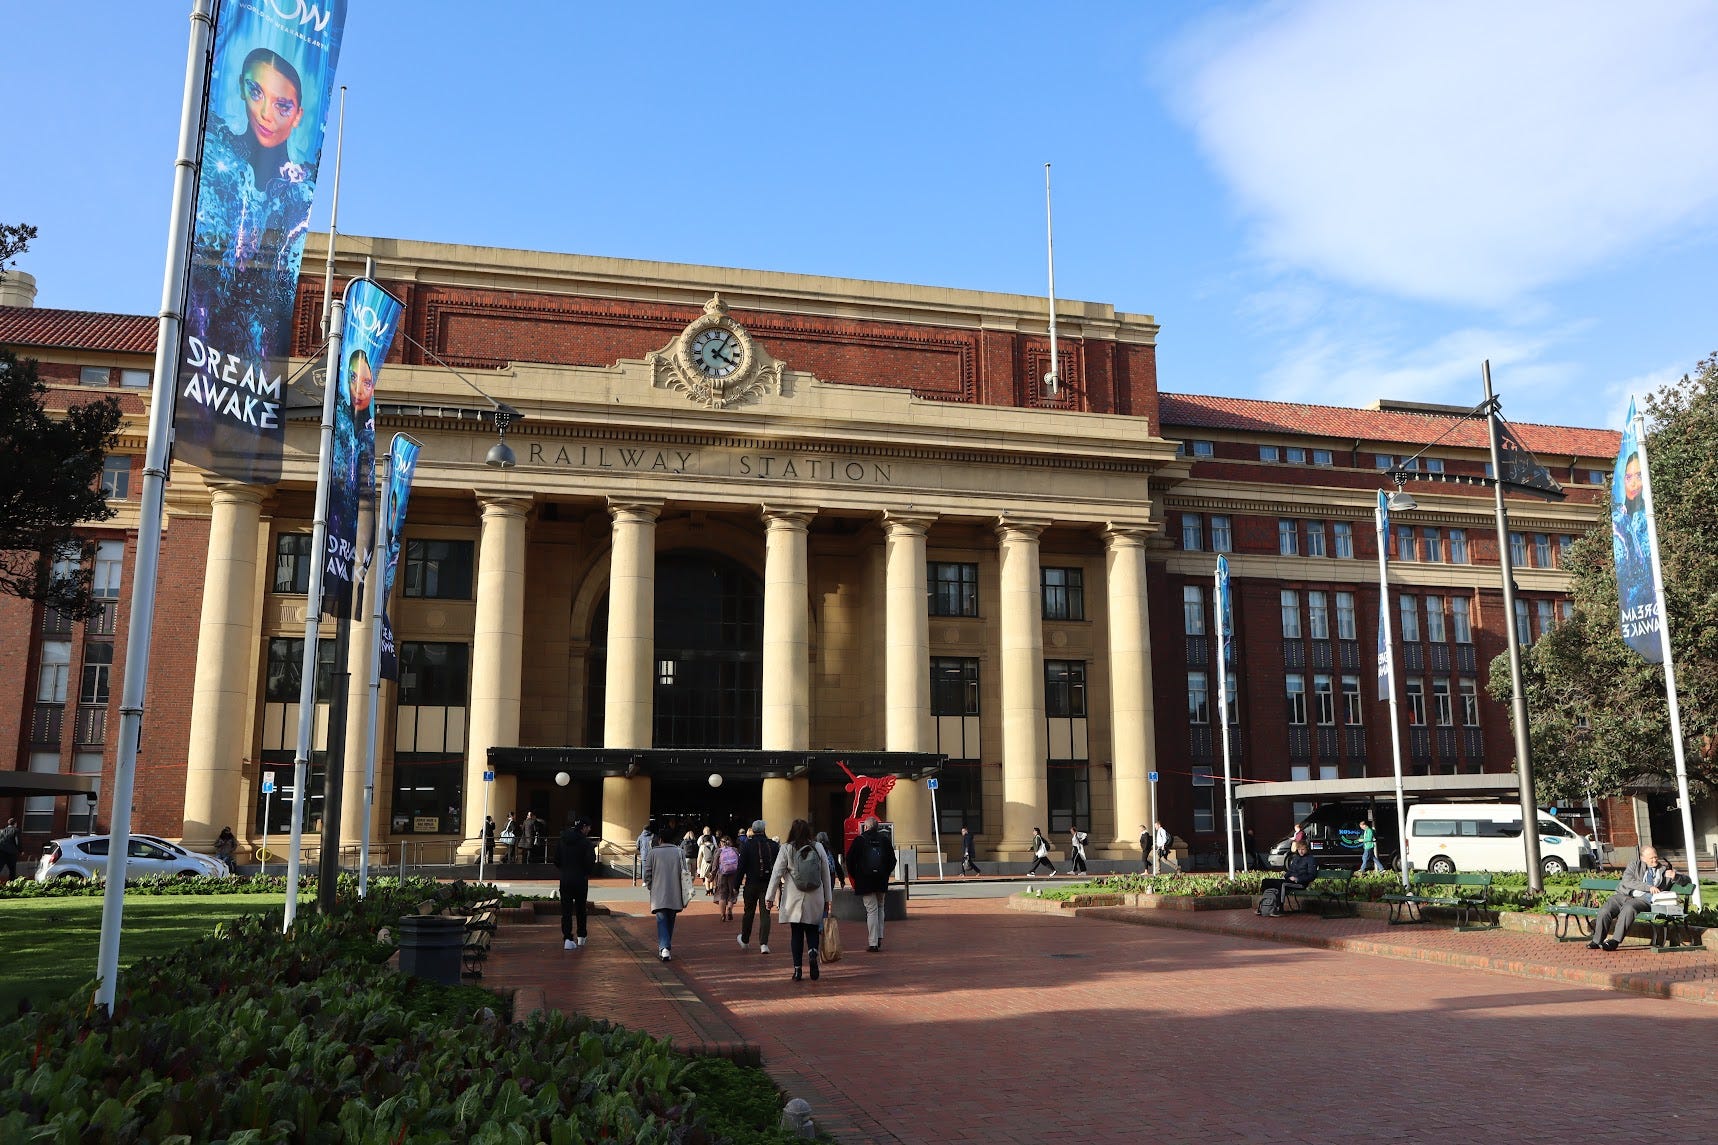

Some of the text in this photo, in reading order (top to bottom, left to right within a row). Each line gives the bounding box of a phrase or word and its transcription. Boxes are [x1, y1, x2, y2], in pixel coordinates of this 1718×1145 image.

[240, 2, 265, 17] WORLD
[275, 21, 312, 43] WEARABLE
[187, 335, 281, 400] DREAM
[183, 372, 280, 429] AWAKE
[529, 443, 892, 482] RAILWAY STATION
